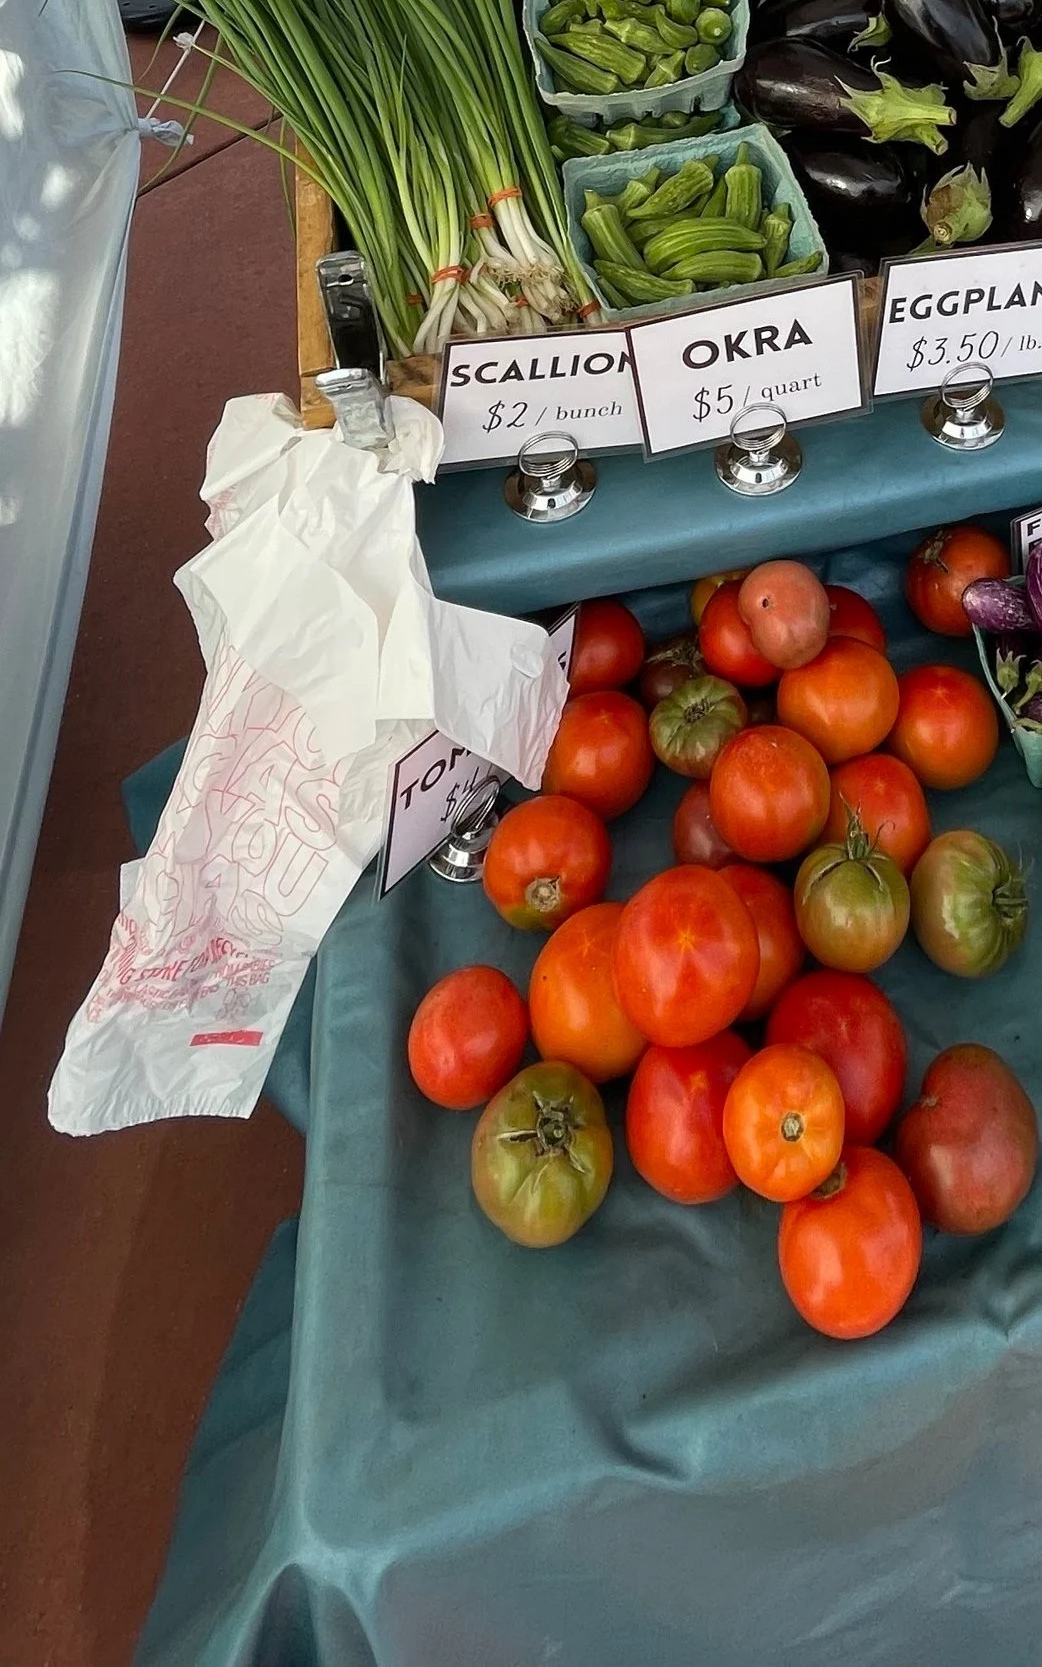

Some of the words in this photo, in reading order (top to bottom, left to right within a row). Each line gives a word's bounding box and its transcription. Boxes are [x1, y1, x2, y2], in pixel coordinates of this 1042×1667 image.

[682, 318, 813, 370] OKRA
[906, 331, 999, 372] $3.50
[1019, 334, 1042, 351] lb.
[482, 400, 528, 434] $2
[556, 401, 622, 421] bunch
[692, 385, 734, 423] $5
[761, 373, 822, 402] quart
